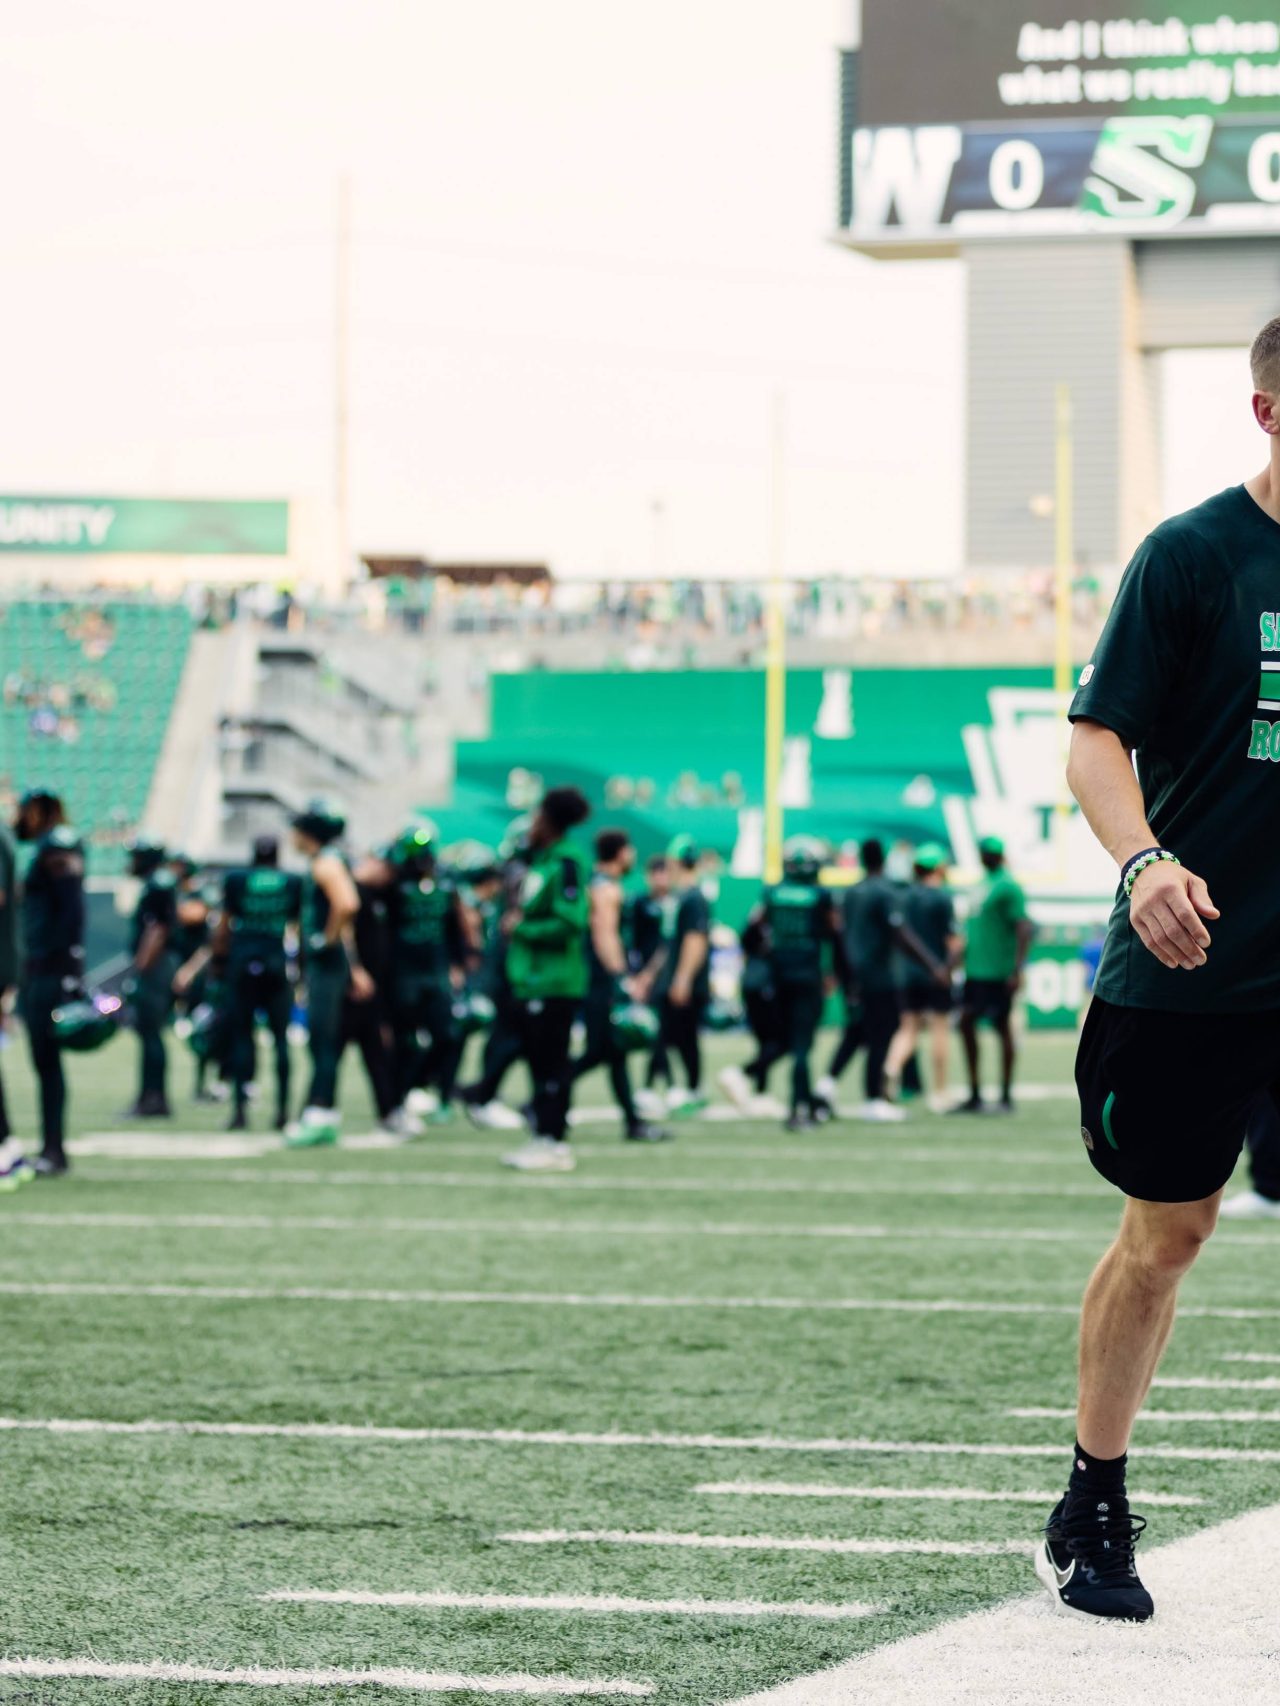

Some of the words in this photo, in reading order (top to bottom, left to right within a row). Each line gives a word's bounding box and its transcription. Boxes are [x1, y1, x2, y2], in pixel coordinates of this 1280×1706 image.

[1102, 17, 1189, 58] think
[1191, 15, 1279, 54] when
[998, 64, 1083, 105] what
[1083, 69, 1132, 102] we
[852, 126, 962, 235] W
[989, 140, 1045, 210] 0
